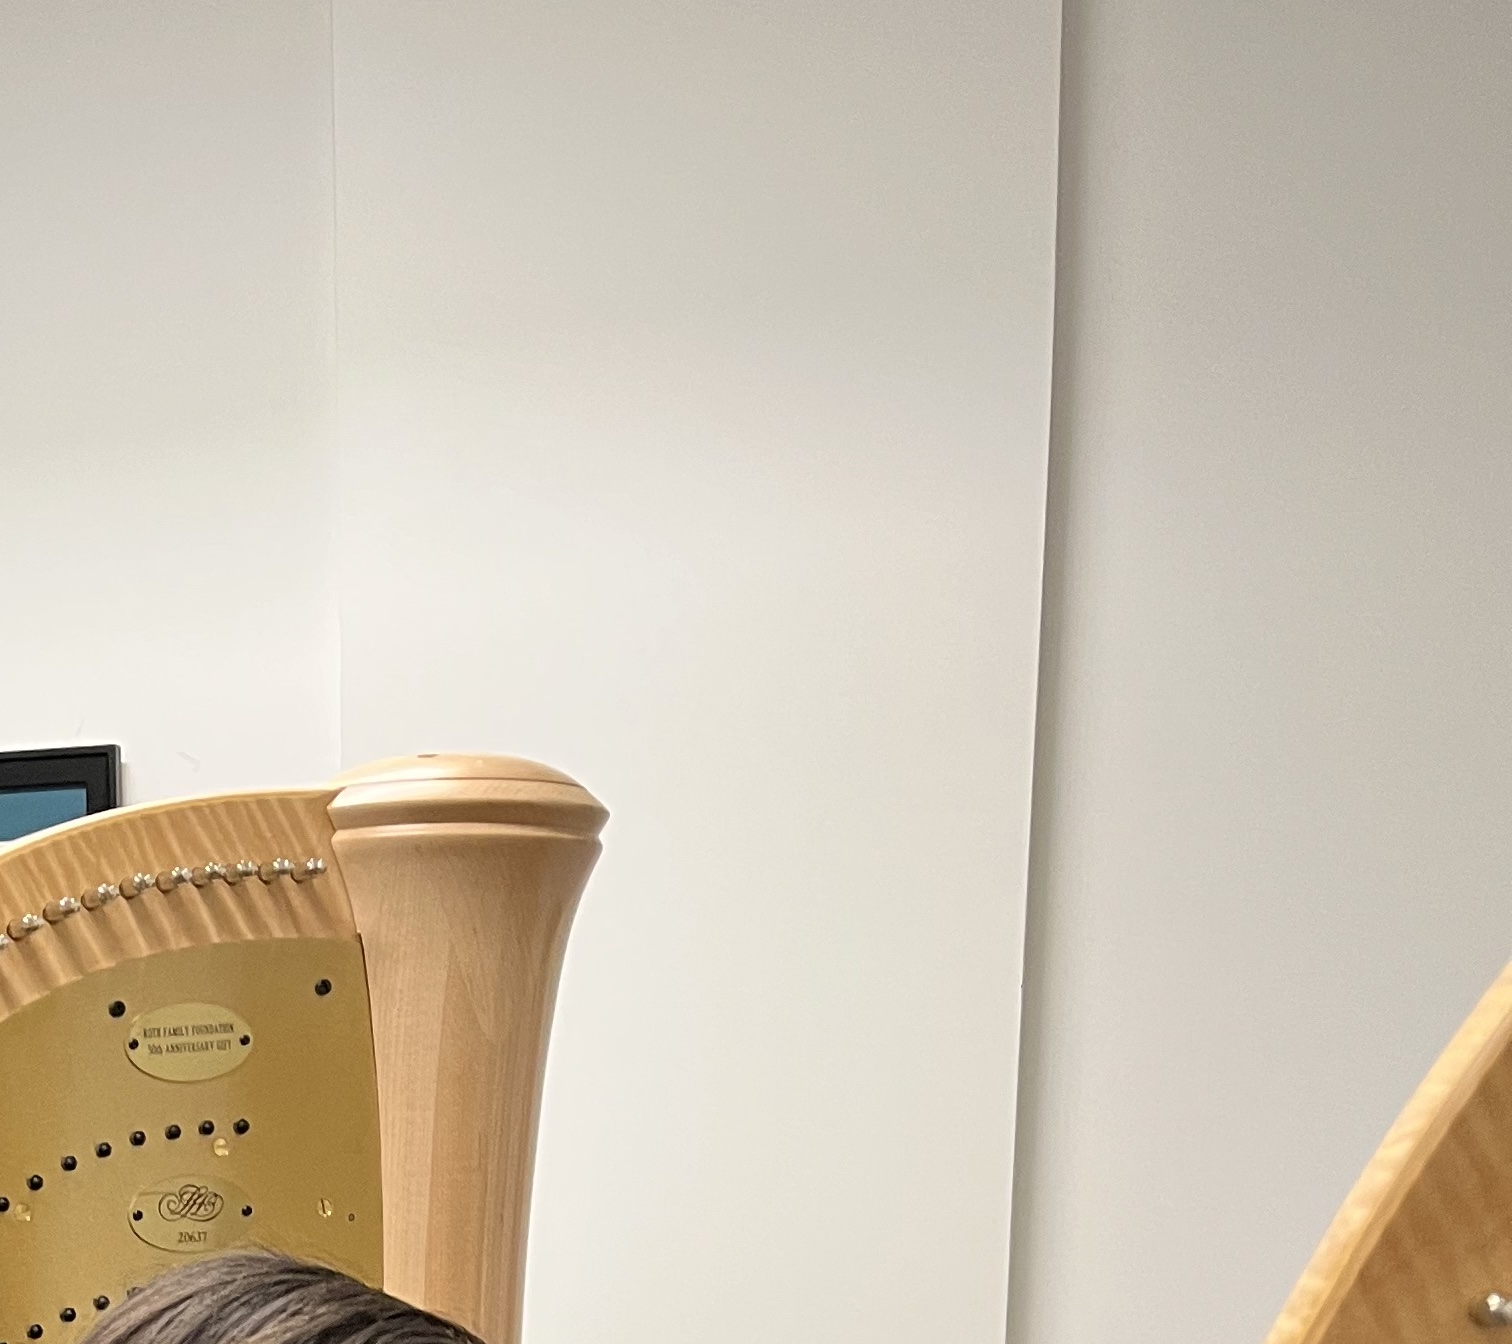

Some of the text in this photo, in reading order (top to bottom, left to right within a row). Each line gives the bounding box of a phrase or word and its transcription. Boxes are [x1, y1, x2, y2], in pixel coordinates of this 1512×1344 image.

[163, 1025, 189, 1038] FAMILY
[191, 1023, 235, 1036] FOUNDATION
[165, 1041, 215, 1053] ANNIVERSARY
